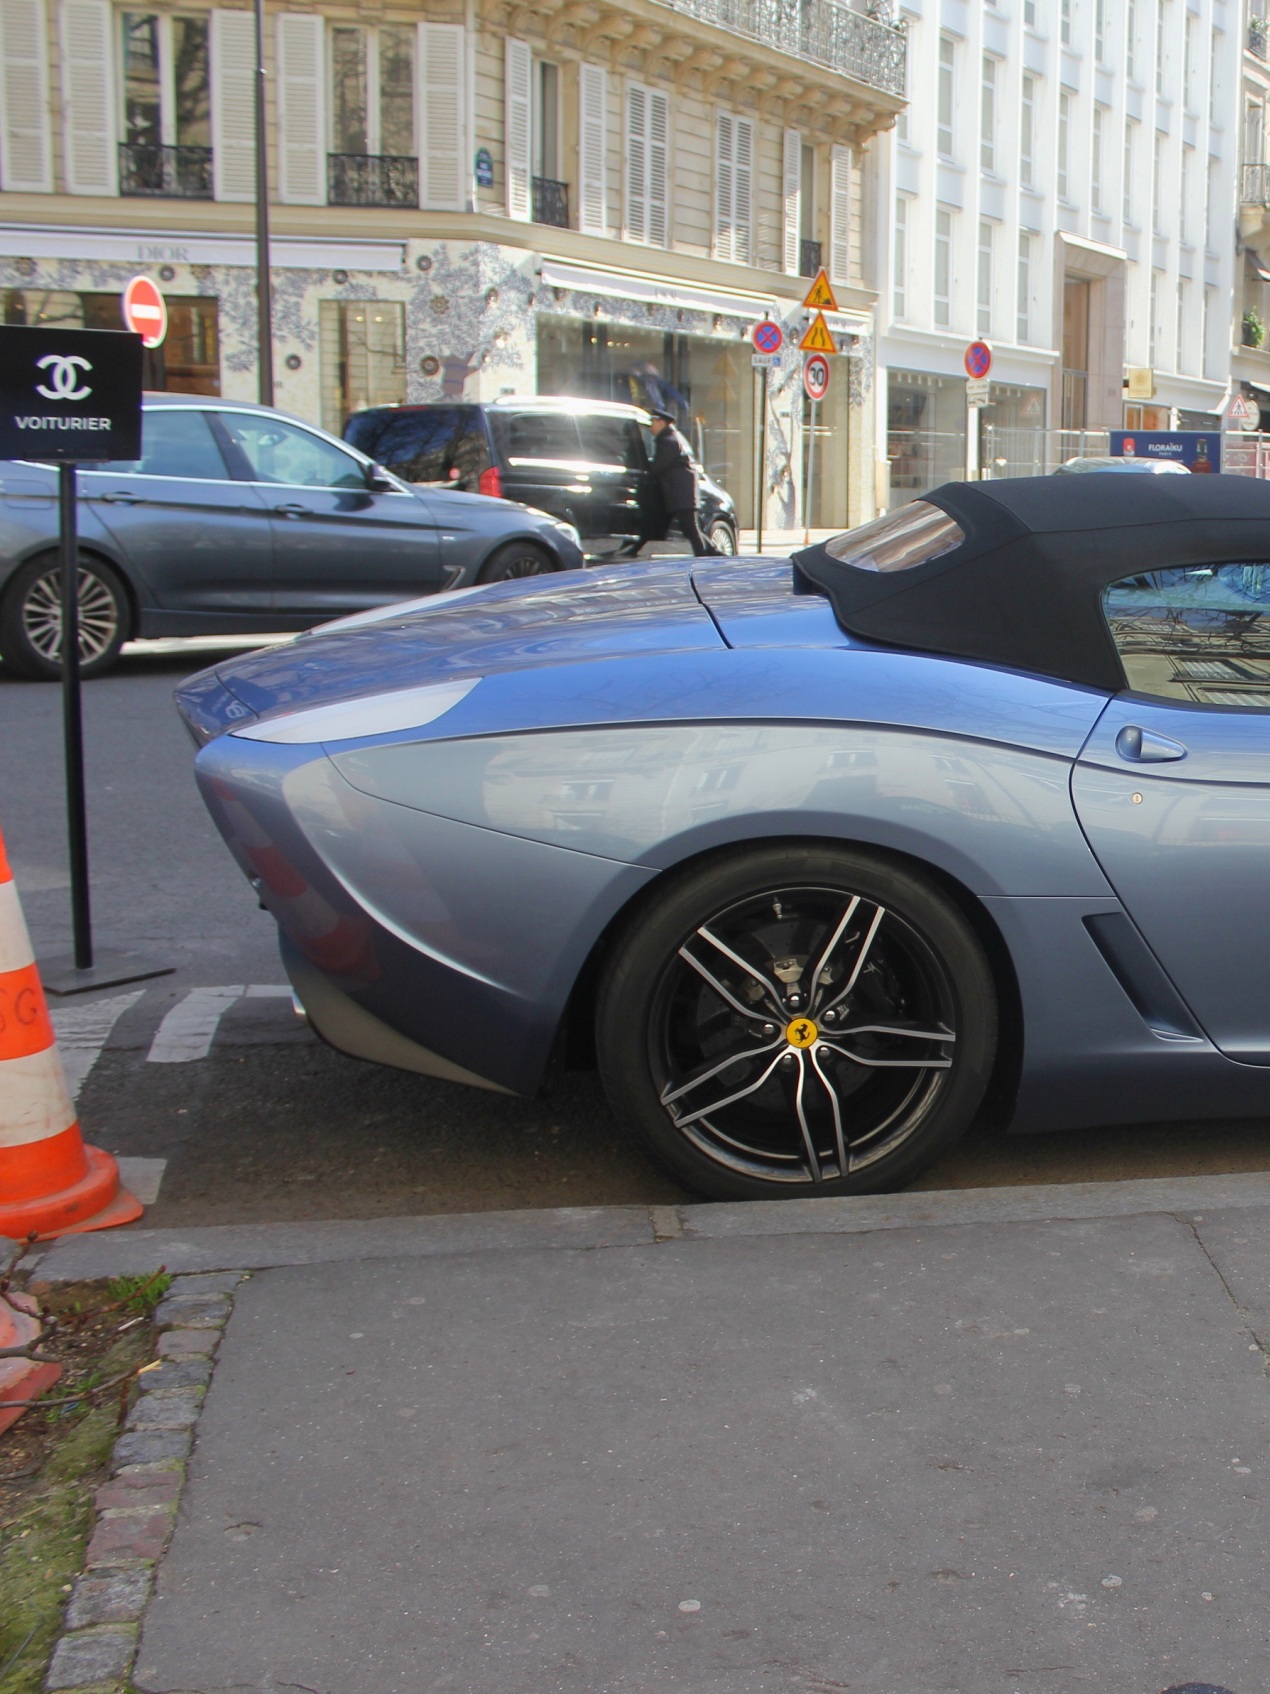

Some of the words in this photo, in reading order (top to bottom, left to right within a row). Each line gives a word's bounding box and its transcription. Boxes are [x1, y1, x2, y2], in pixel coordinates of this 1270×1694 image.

[137, 246, 188, 261] DIOR
[753, 355, 771, 363] SAUF
[809, 367, 825, 386] 30
[15, 416, 112, 430] VOITURIER
[1148, 442, 1183, 452] FLORAÏKU
